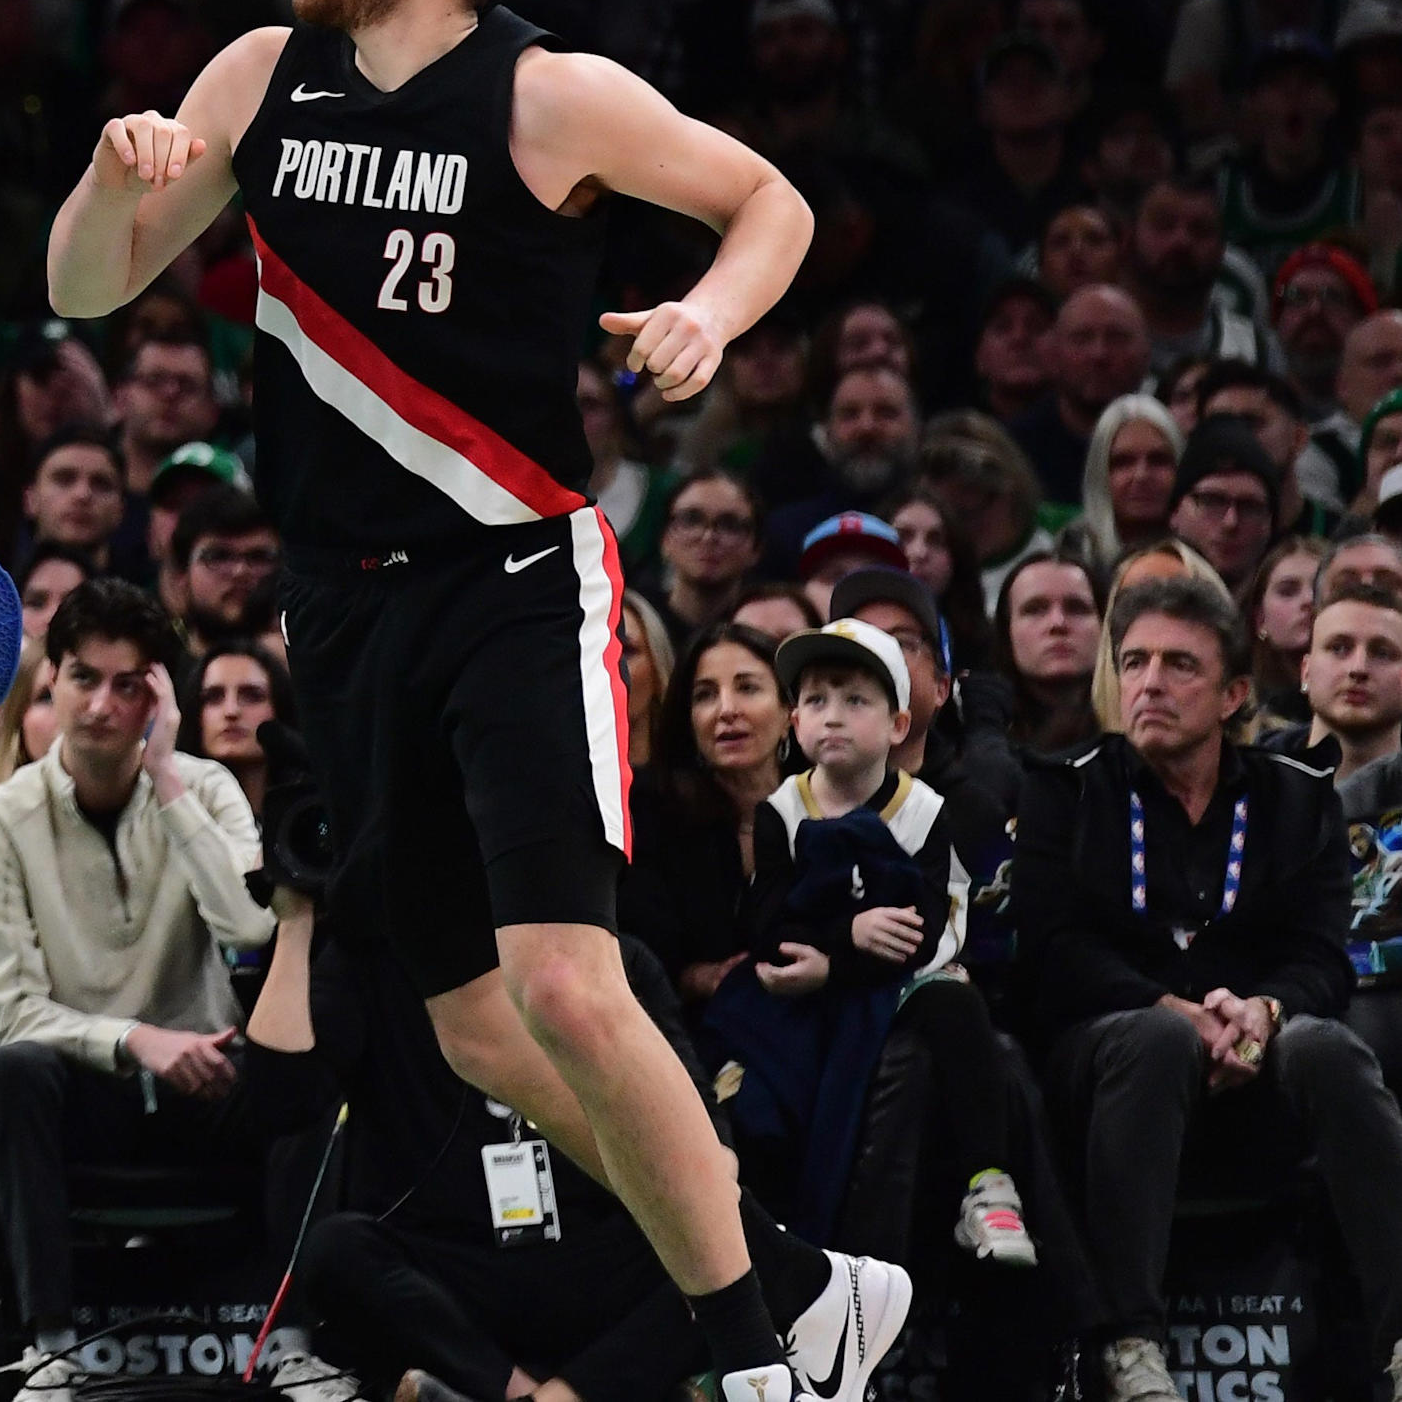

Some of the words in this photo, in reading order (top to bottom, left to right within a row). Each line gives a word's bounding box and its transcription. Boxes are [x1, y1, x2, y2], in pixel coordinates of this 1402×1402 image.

[272, 138, 469, 215] PORTLAND
[377, 228, 457, 314] 23
[1230, 1295, 1285, 1314] SEAT
[80, 1333, 274, 1376] OSTON
[1169, 1324, 1290, 1367] TON
[1171, 1370, 1286, 1402] TICS
